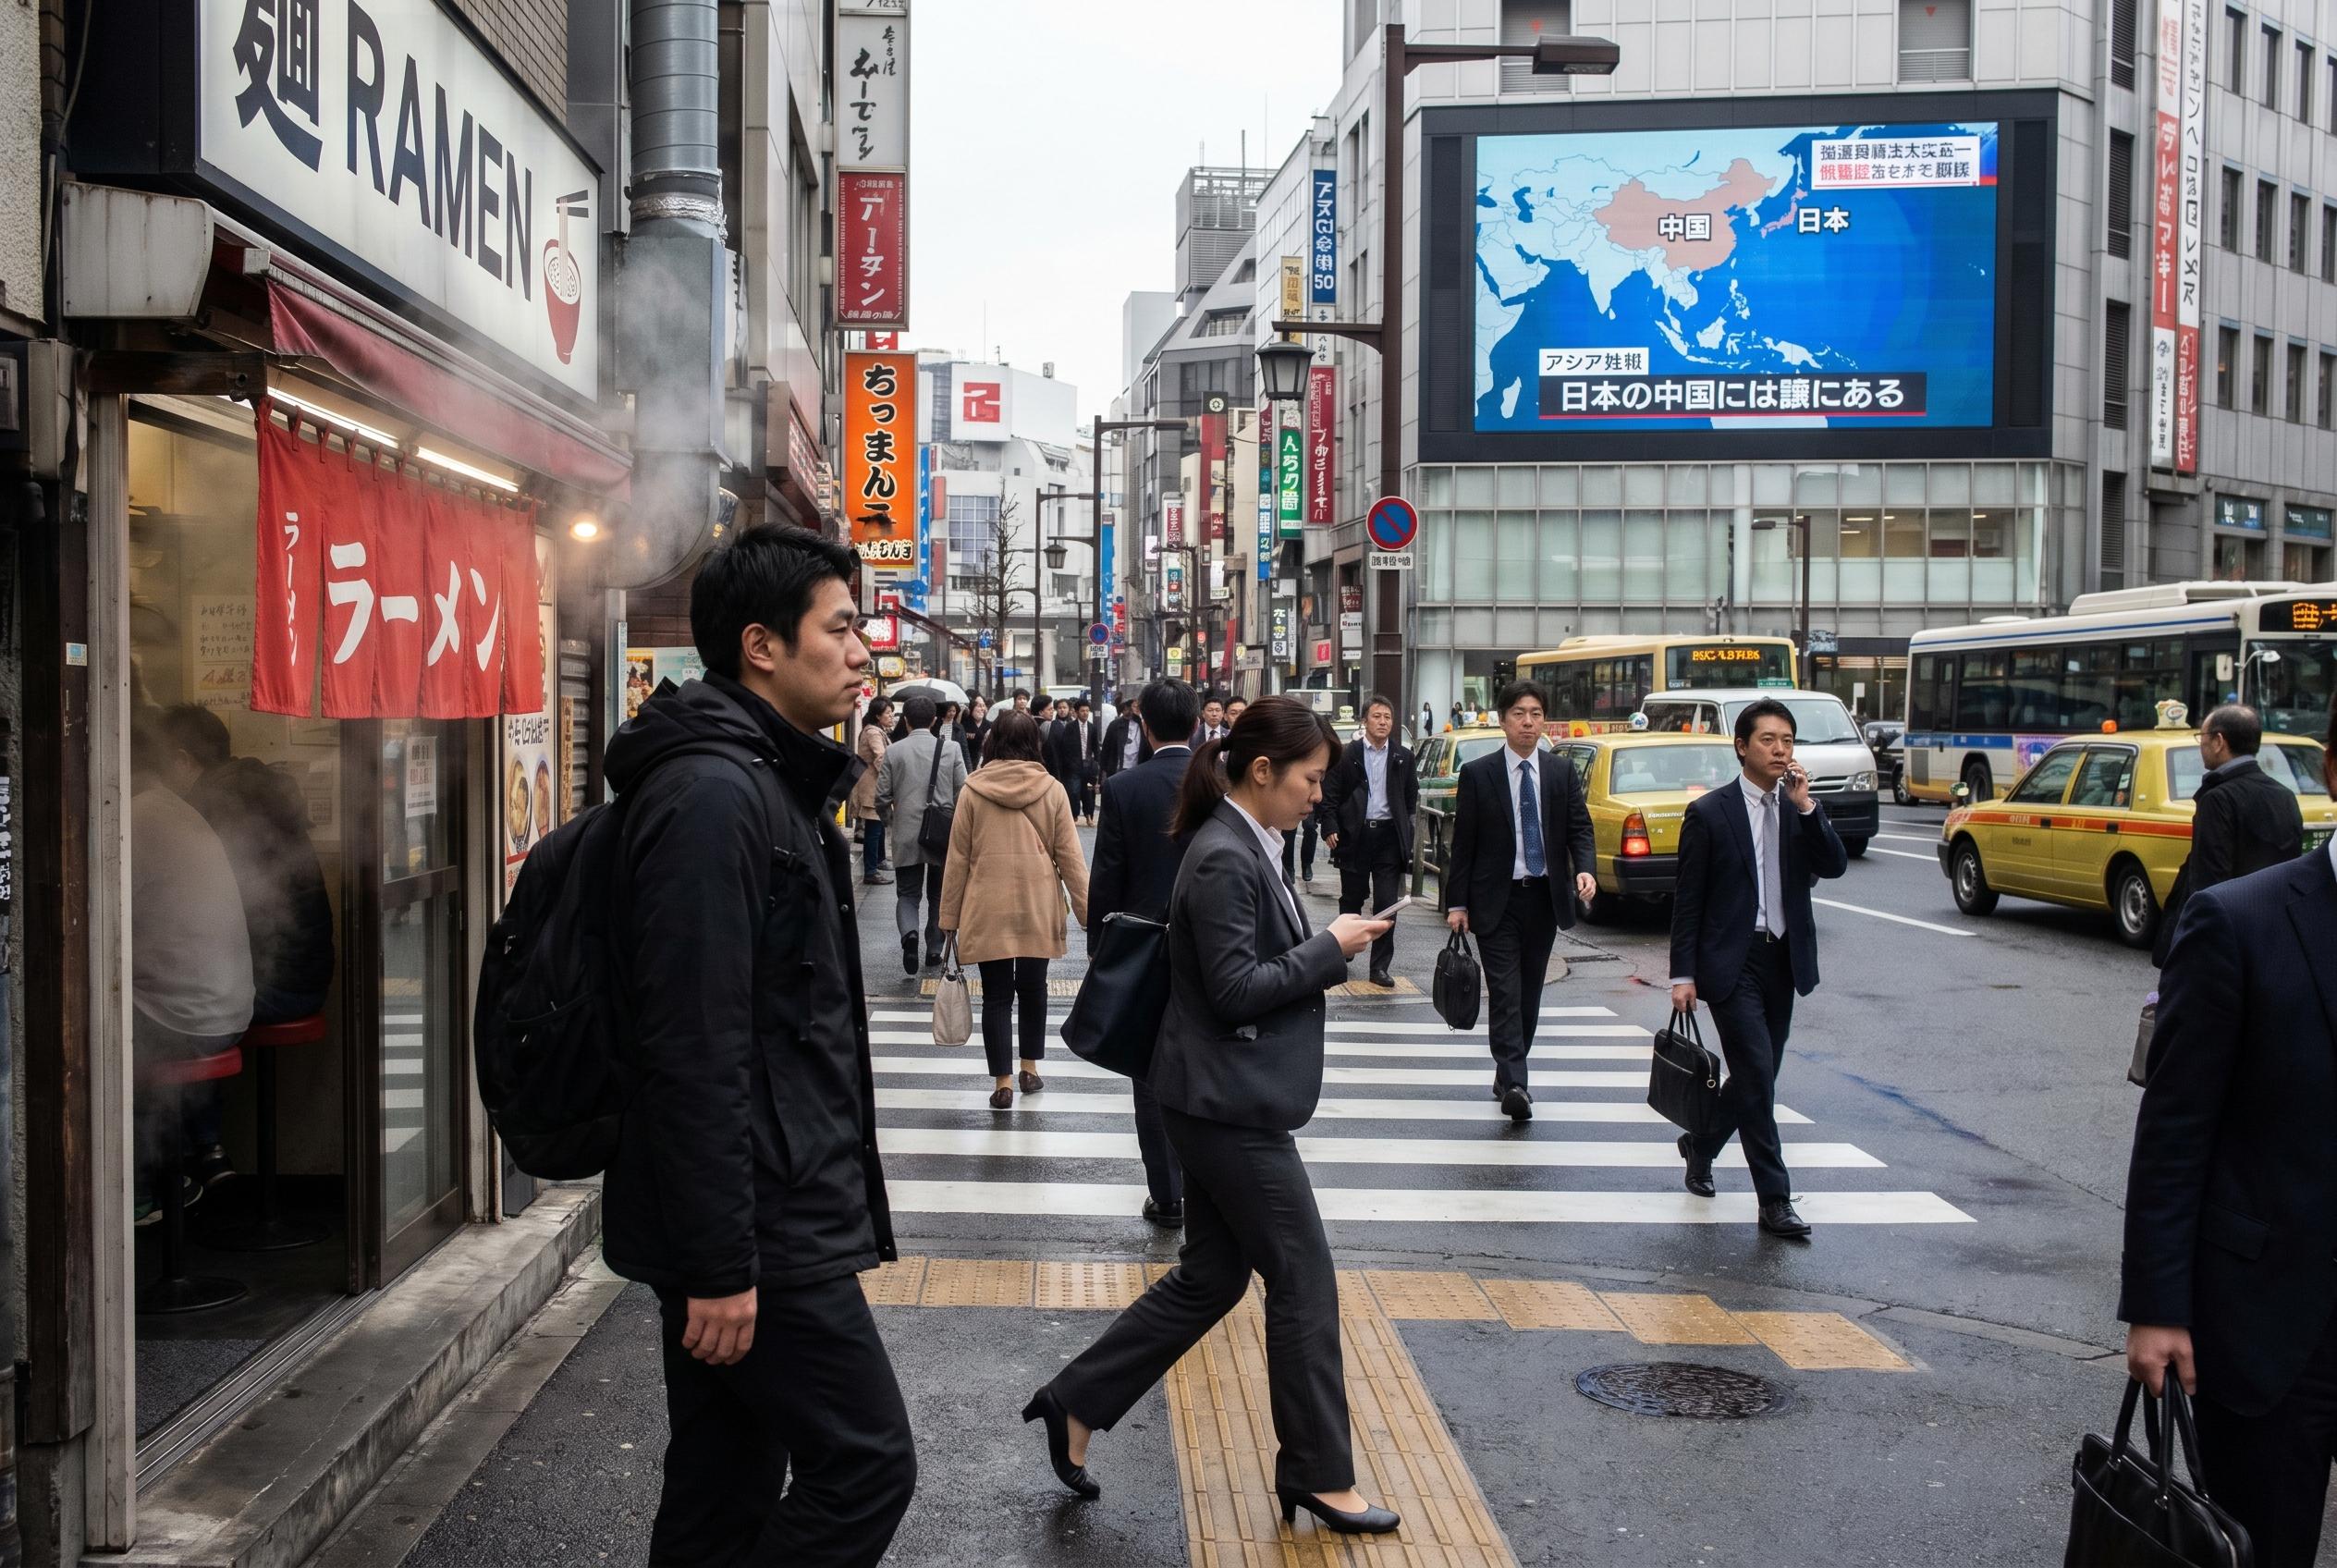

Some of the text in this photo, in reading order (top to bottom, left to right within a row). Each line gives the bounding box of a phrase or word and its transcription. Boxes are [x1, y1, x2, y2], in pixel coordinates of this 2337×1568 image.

[348, 0, 532, 302] RAMEN
[1658, 214, 1711, 241] 中国
[1798, 206, 1850, 234] 日本
[285, 511, 300, 667] ラーメン
[328, 542, 500, 672] ラーメン
